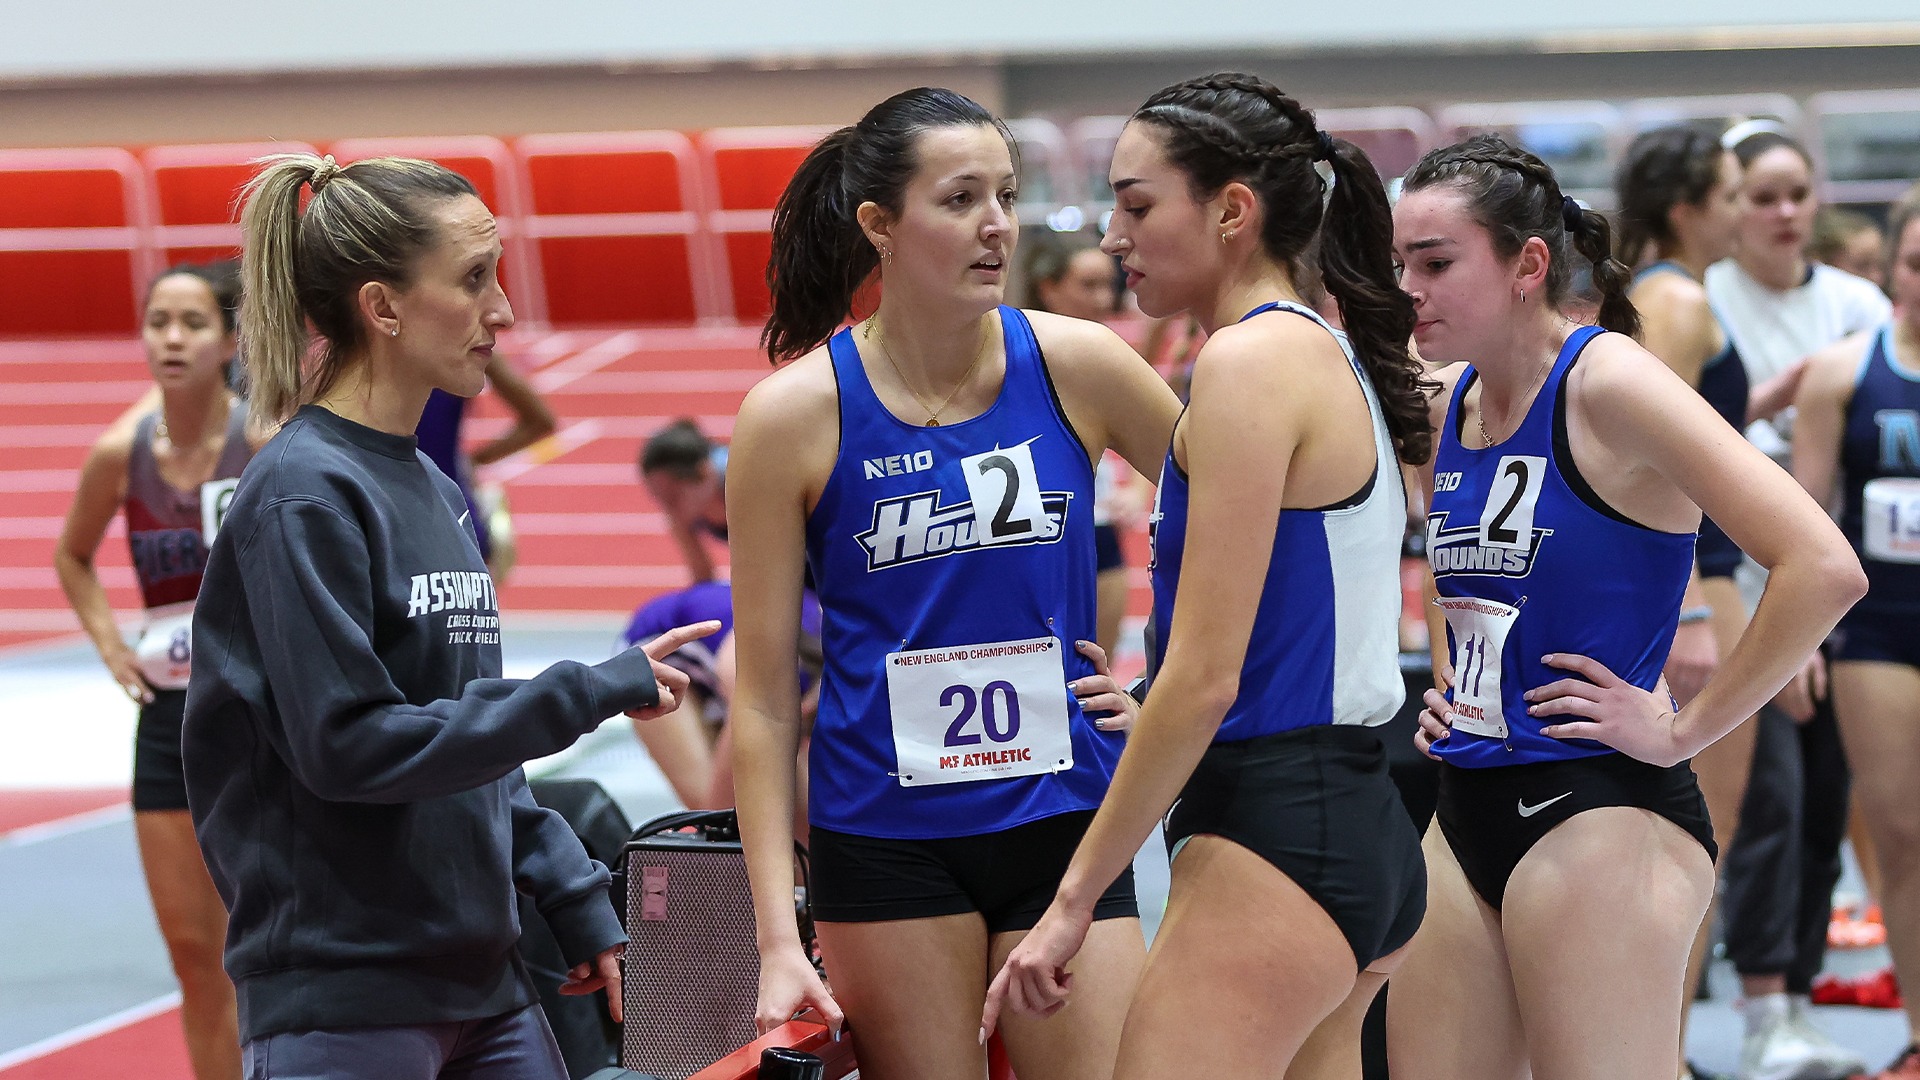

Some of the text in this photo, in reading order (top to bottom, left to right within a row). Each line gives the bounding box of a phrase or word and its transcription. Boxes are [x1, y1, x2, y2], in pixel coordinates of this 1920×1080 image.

[863, 450, 933, 480] NE10
[978, 455, 1032, 538] 2
[861, 495, 1063, 566] HOUS
[1487, 460, 1529, 544] 2
[407, 571, 499, 618] ASSUMPTI
[900, 642, 1049, 667] NEW ENGLAND CHAMPIONSHIPS
[1461, 633, 1485, 698] 11
[939, 680, 1021, 748] 20
[963, 748, 1032, 768] ATHLETIC
